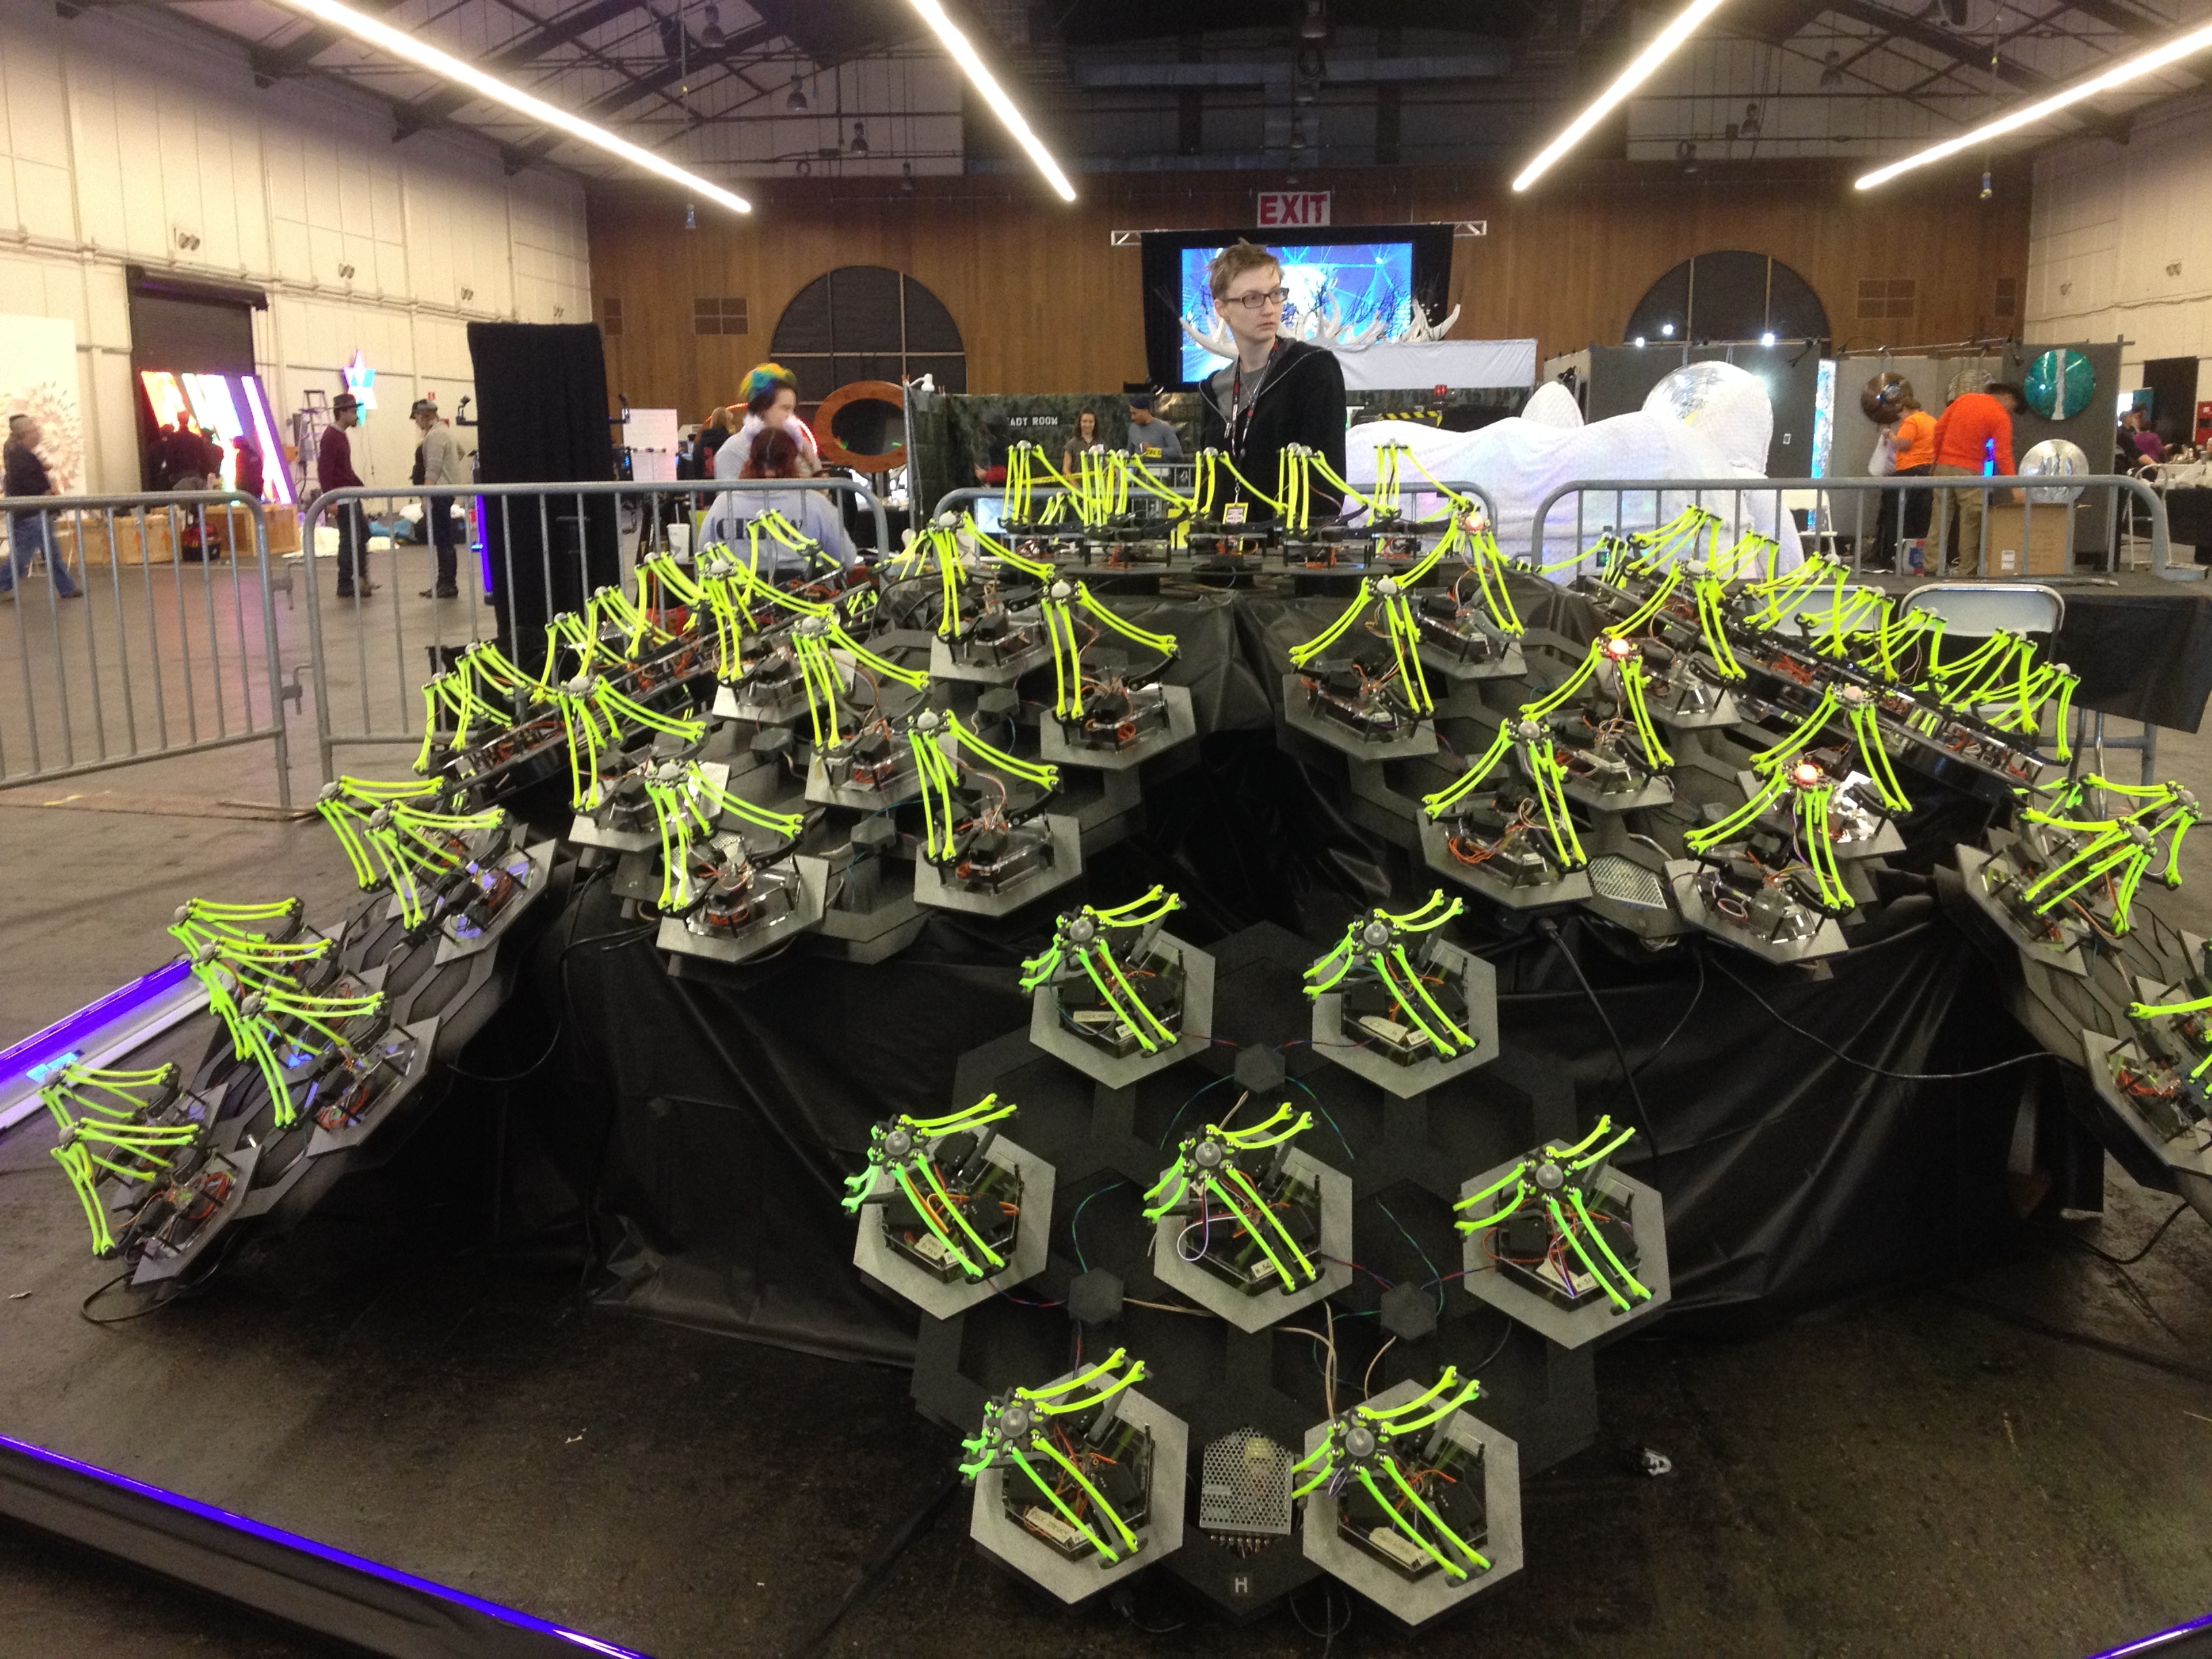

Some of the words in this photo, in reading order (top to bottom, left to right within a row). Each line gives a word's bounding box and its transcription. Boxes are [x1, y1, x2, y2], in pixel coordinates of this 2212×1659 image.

[1261, 194, 1327, 225] EXIT
[1006, 417, 1028, 426] ADY
[1032, 416, 1058, 426] ROOM
[1235, 1576, 1248, 1593] H
